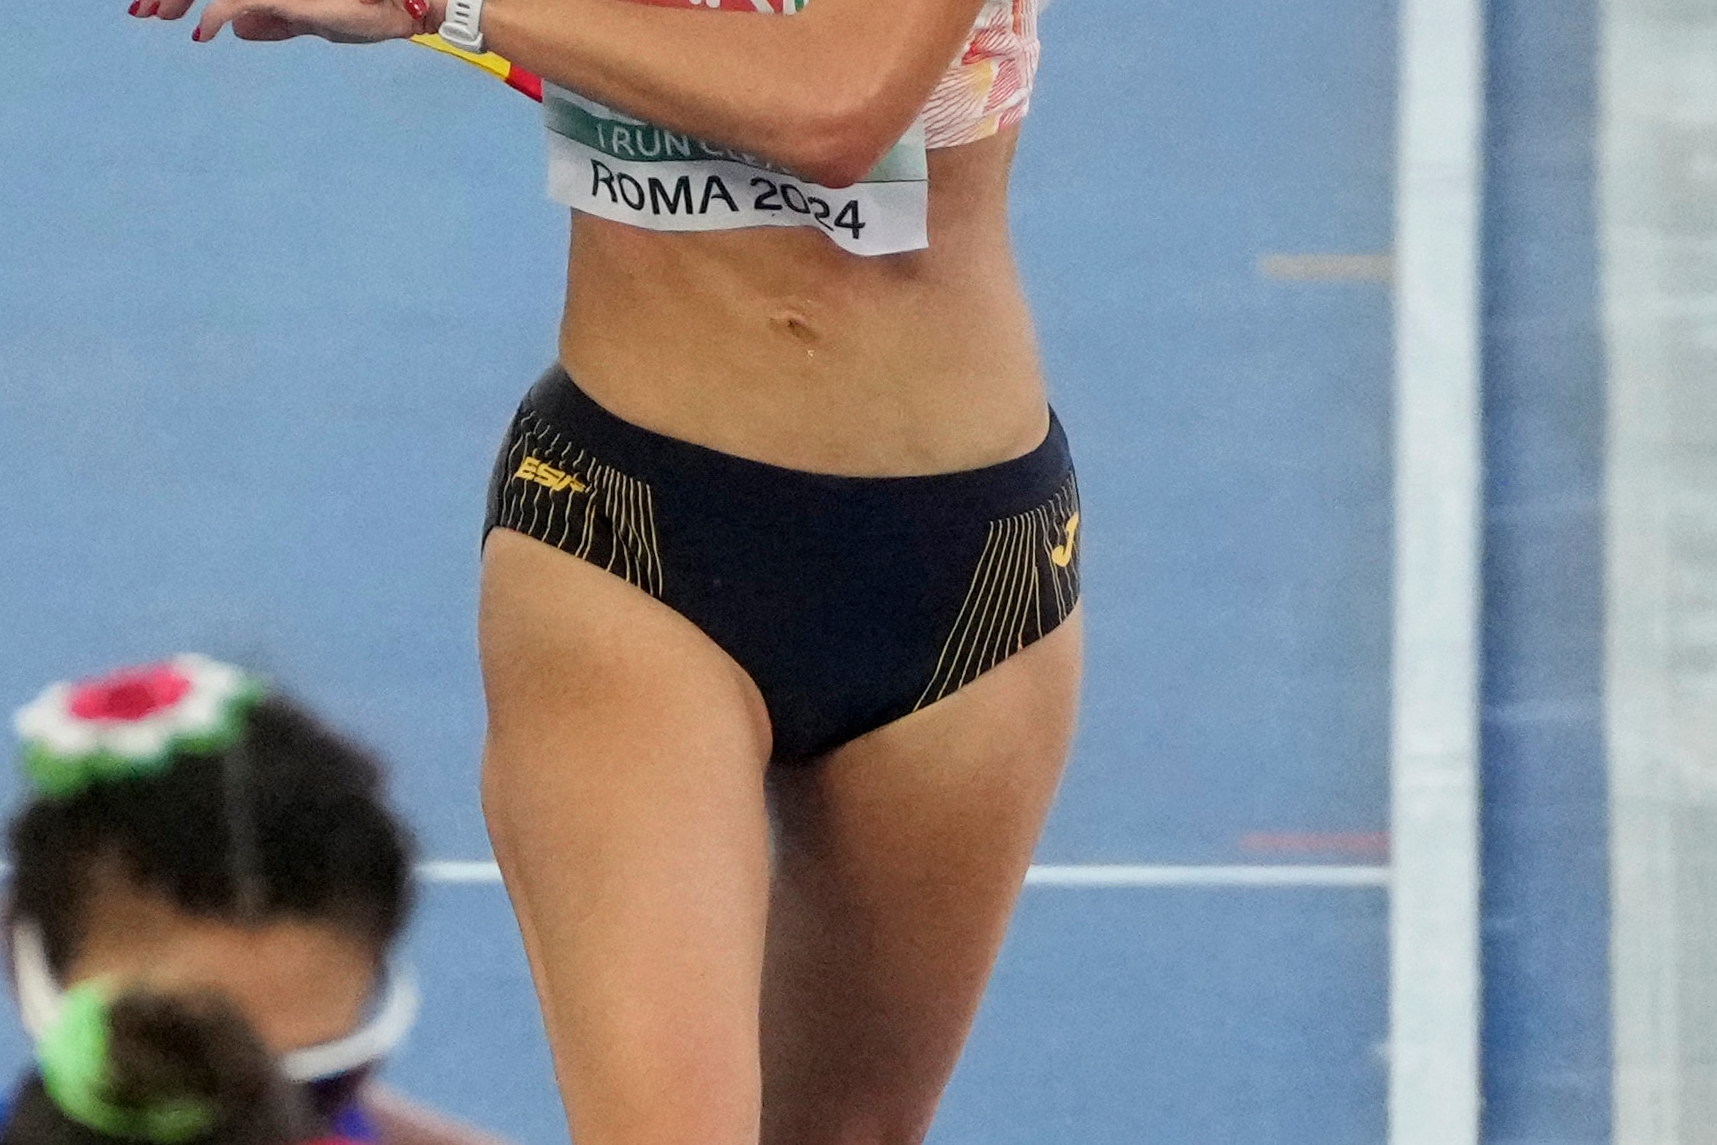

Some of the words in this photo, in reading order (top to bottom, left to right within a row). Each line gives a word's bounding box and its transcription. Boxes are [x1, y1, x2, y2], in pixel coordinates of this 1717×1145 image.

[612, 125, 691, 157] RUN
[590, 158, 739, 215] ROMA
[750, 176, 866, 240] 2024
